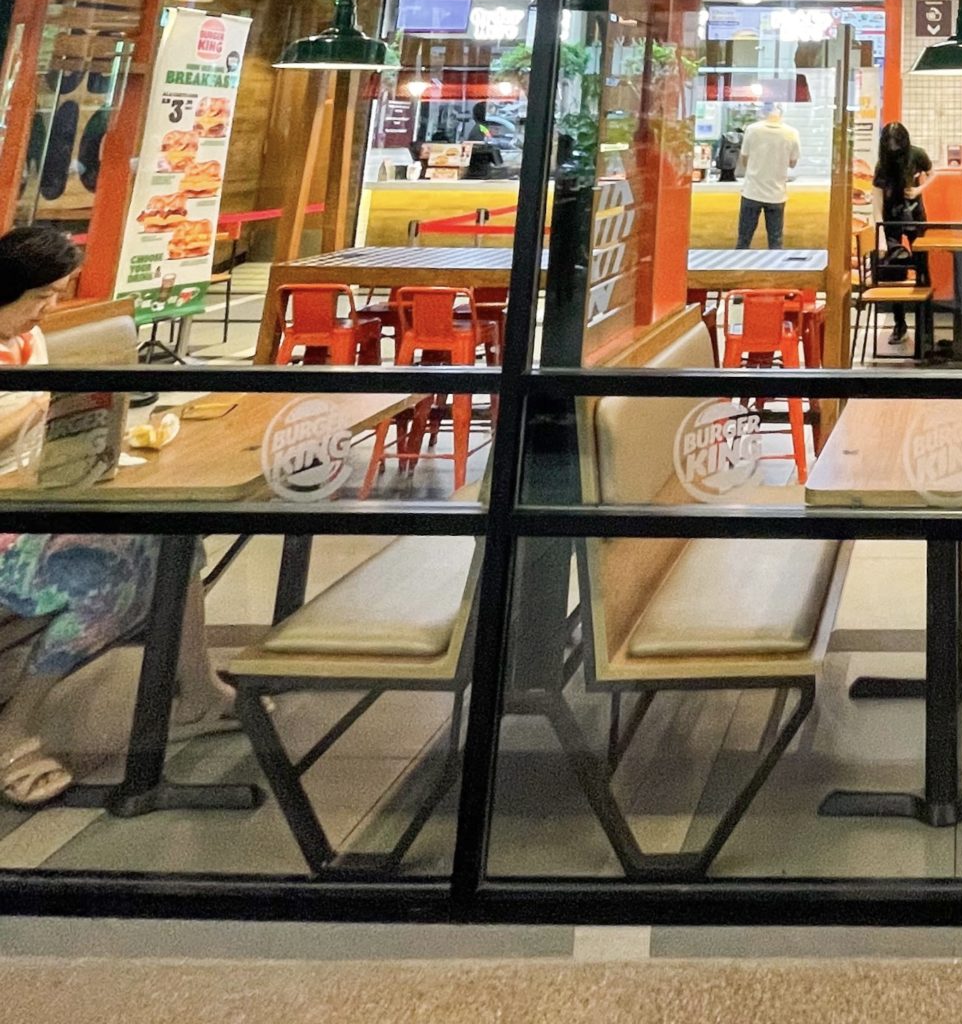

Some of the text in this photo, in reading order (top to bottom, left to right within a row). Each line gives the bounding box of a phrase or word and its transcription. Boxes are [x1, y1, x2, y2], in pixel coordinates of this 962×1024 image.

[197, 39, 223, 53] KING
[272, 430, 352, 483] KING
[684, 415, 760, 456] BURGER
[686, 434, 763, 483] KING
